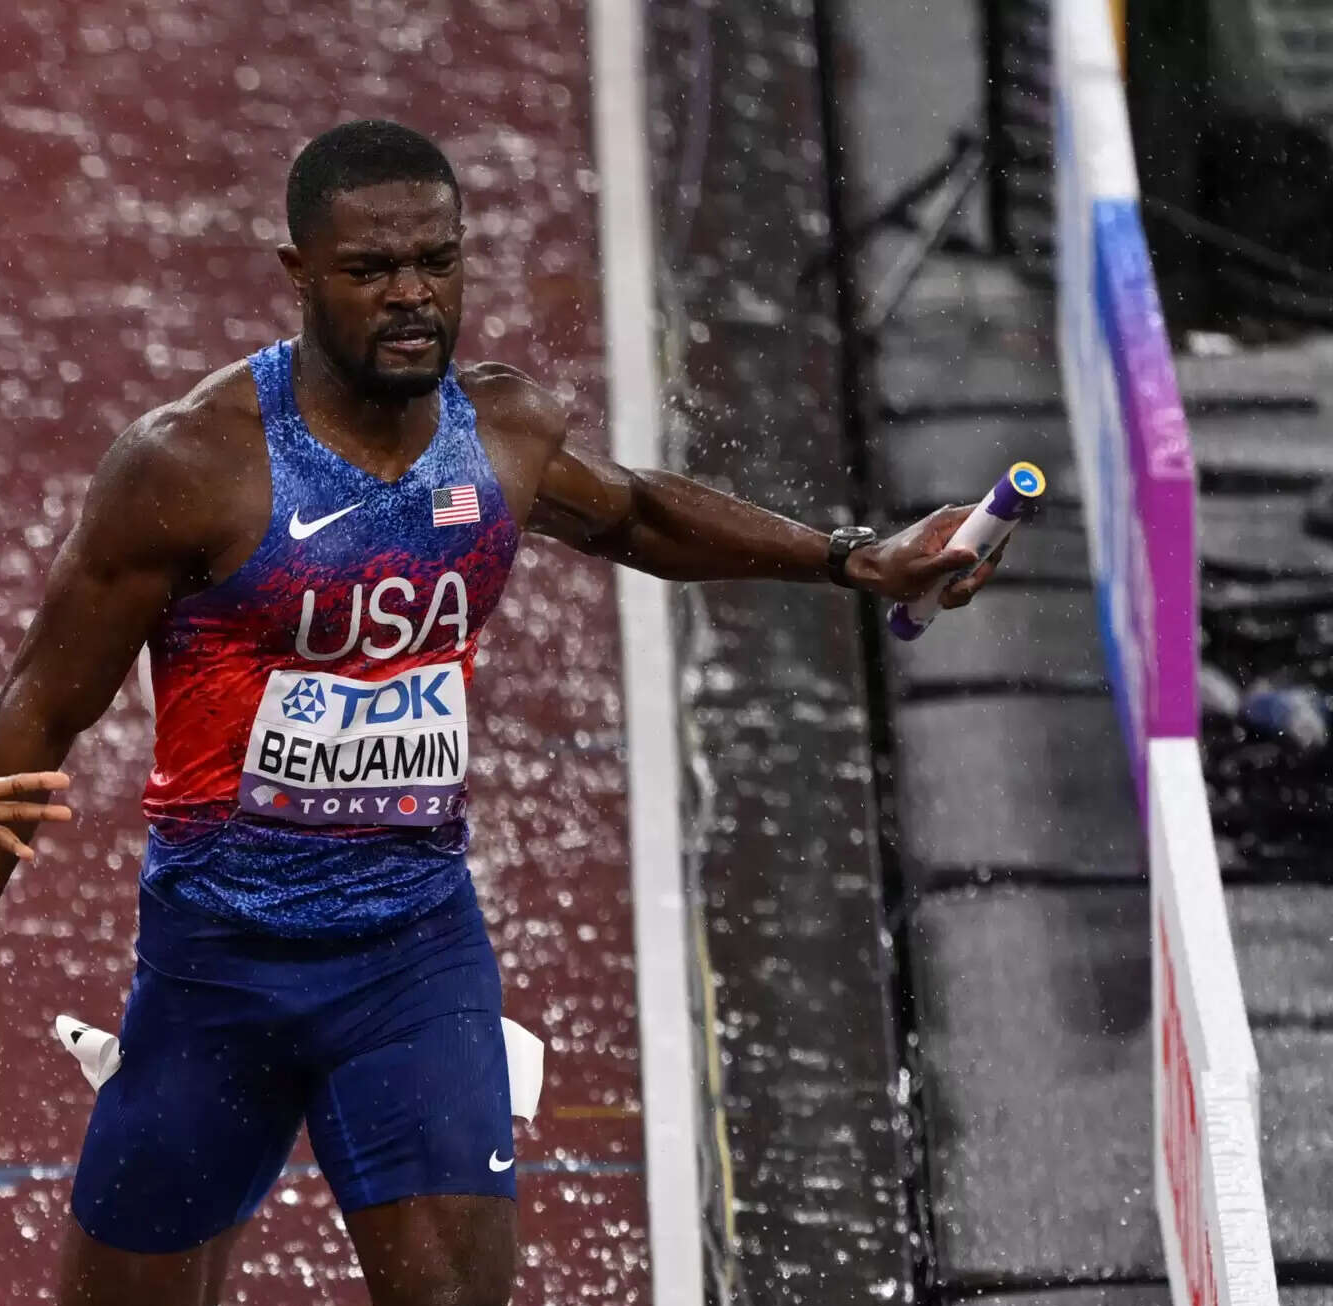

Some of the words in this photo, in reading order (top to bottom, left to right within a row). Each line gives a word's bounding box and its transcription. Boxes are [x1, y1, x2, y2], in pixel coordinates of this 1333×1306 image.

[295, 571, 468, 661] USA
[330, 671, 452, 729] TDK
[257, 730, 459, 783] BENJAMIN
